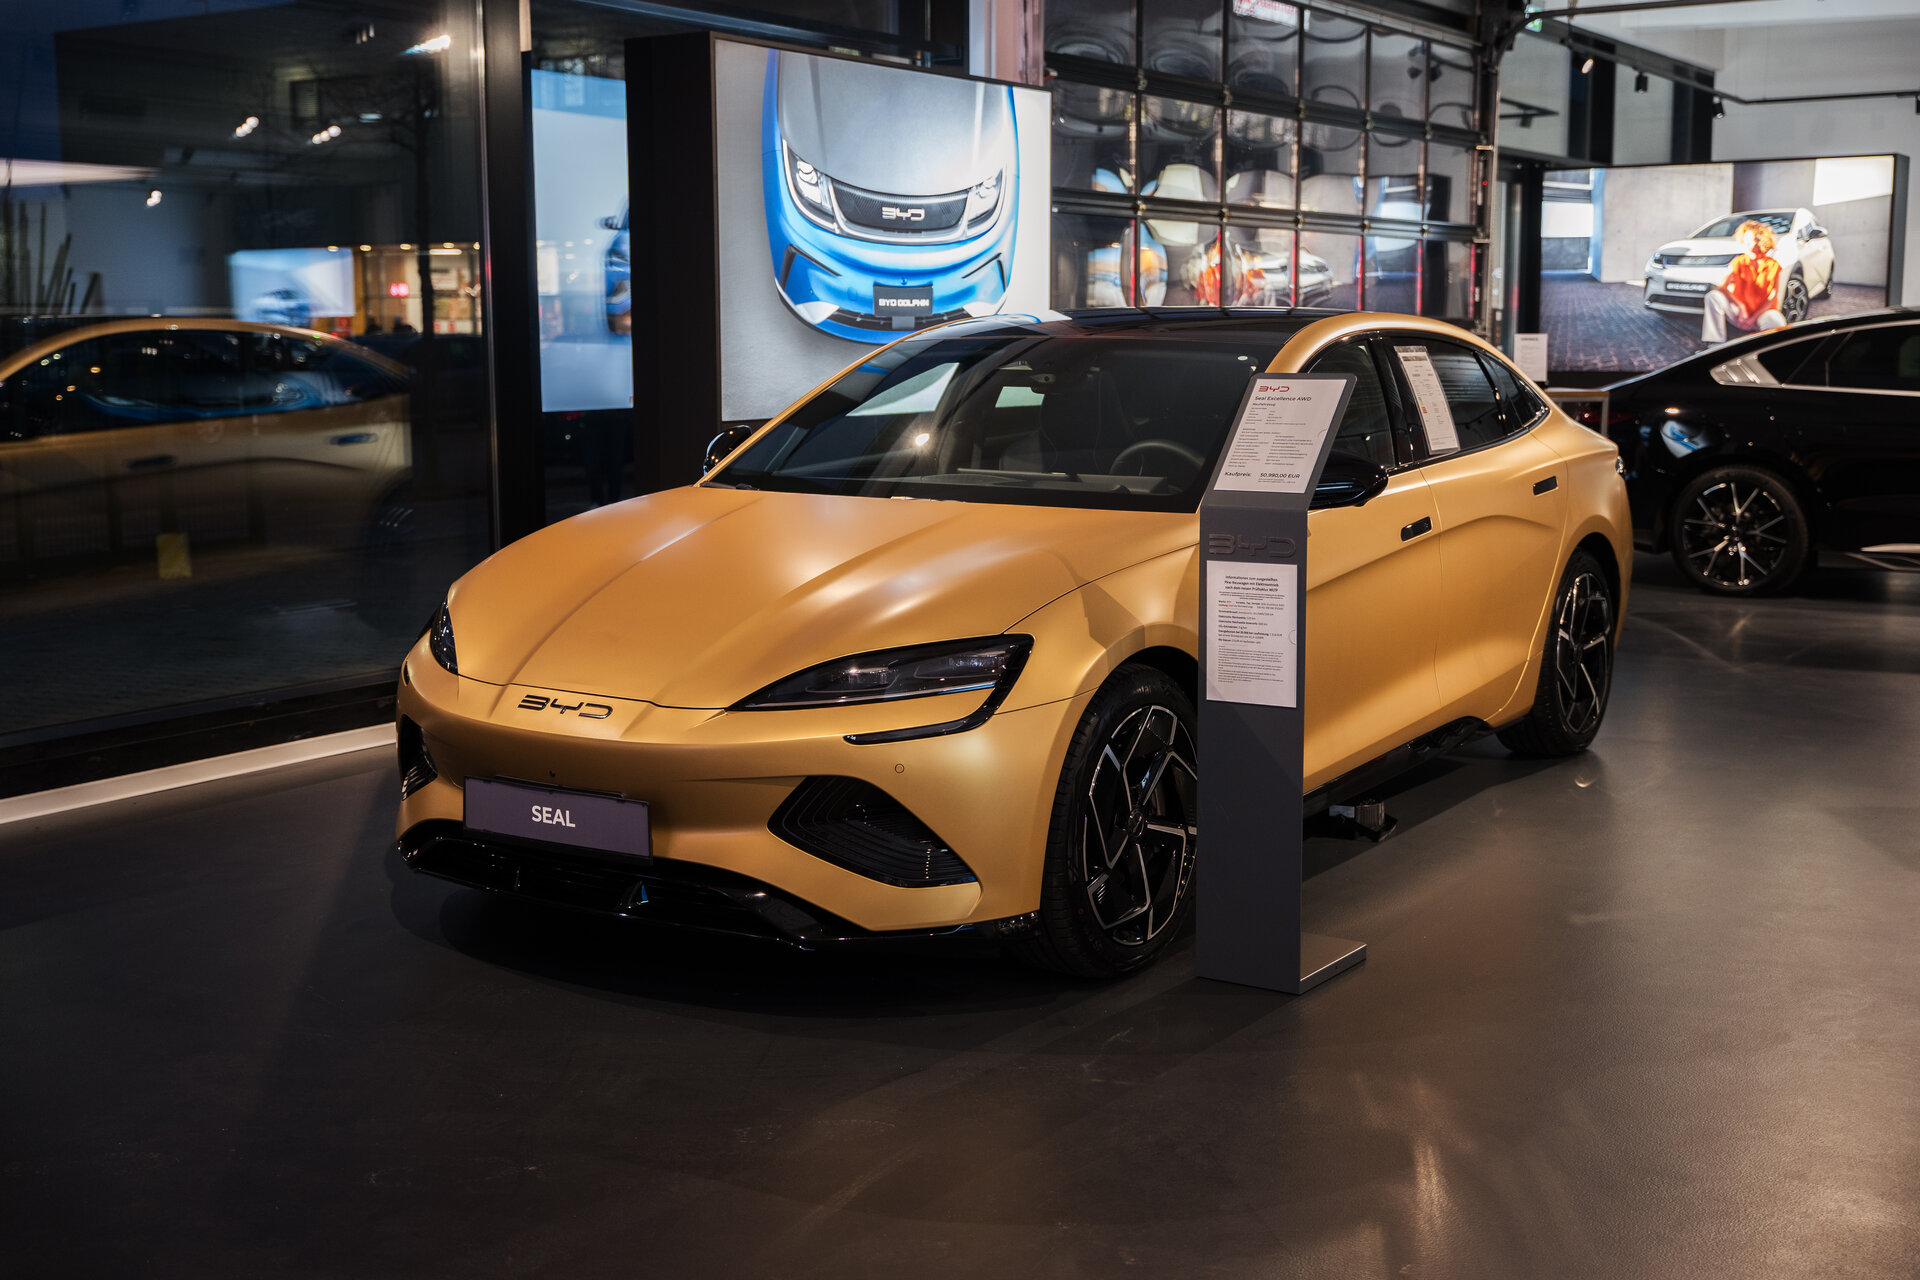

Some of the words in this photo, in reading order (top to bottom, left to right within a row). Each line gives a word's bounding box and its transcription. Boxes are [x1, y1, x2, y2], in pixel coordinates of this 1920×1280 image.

[882, 206, 925, 221] BYD
[879, 299, 896, 307] BYD
[898, 299, 929, 307] DOLPHIN
[1208, 533, 1296, 558] BYD
[518, 694, 613, 720] BYD
[531, 805, 576, 828] SEAL
